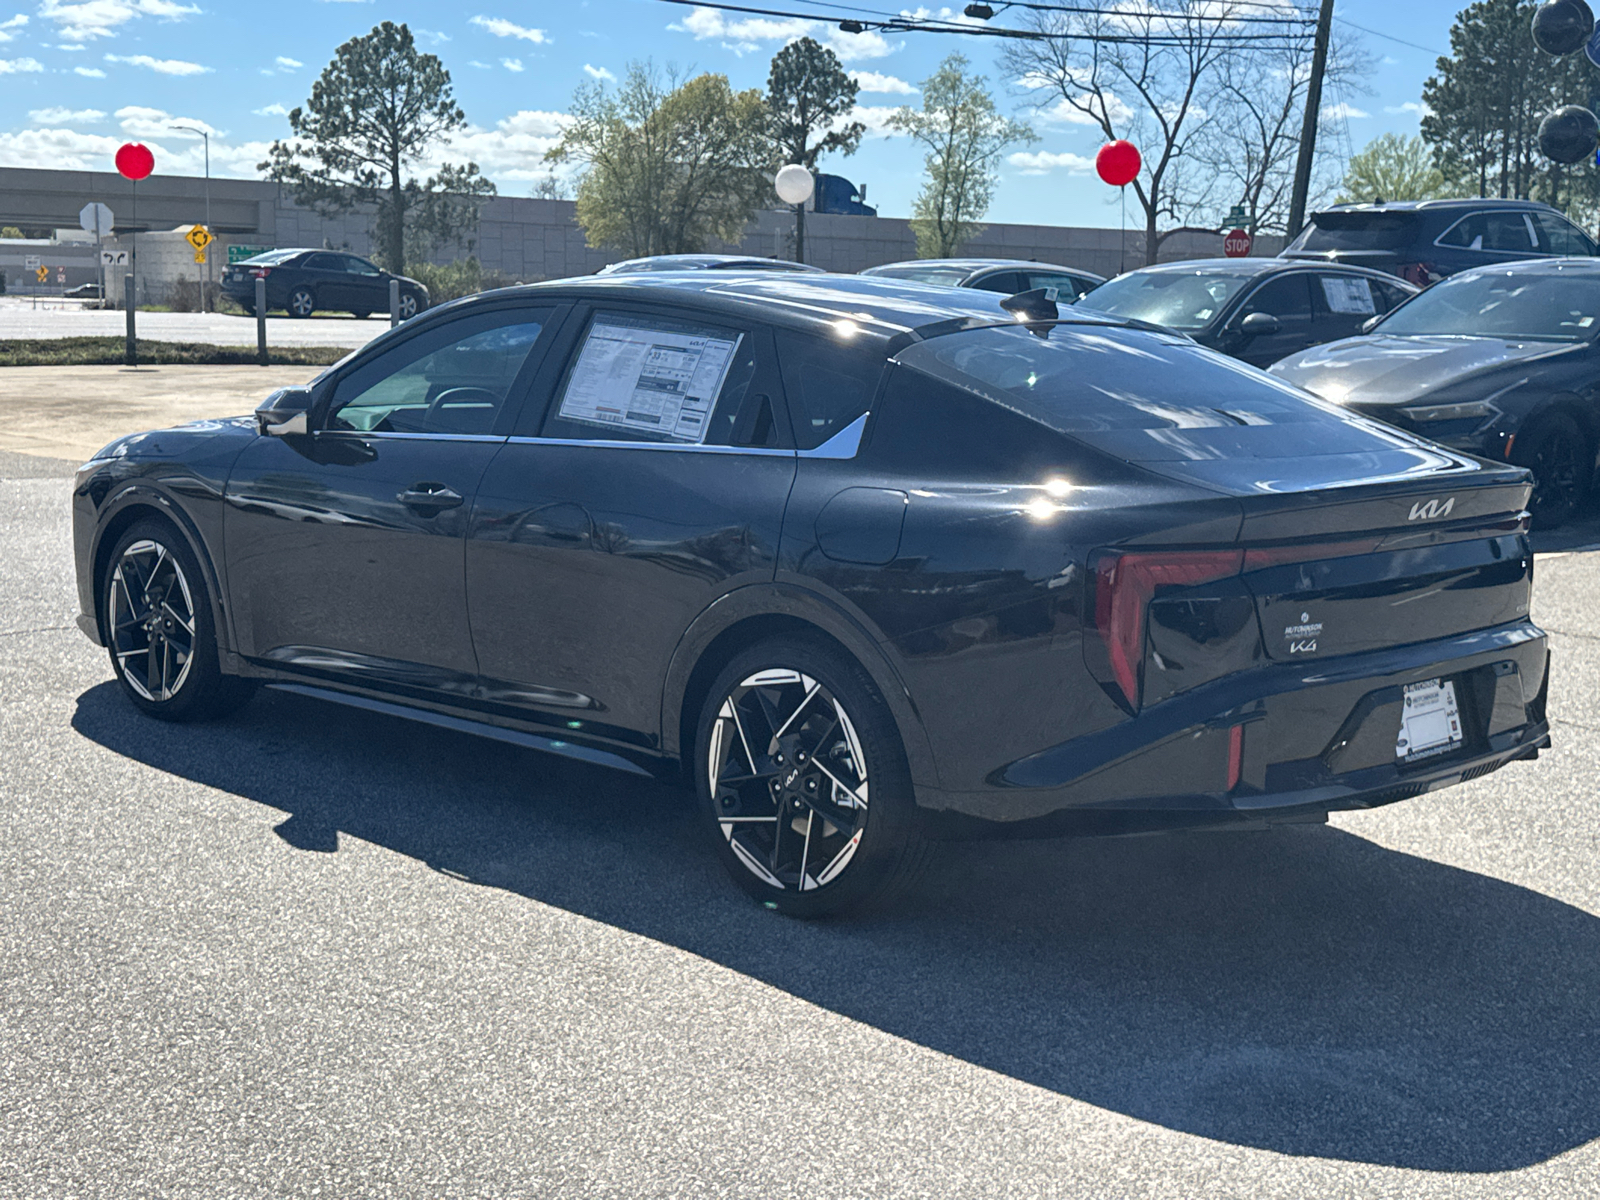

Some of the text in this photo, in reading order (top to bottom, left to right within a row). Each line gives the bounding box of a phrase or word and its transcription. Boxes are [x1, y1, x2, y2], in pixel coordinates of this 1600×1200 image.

[1226, 239, 1250, 252] STOP
[1408, 497, 1455, 520] KIA
[1290, 639, 1317, 654] K4
